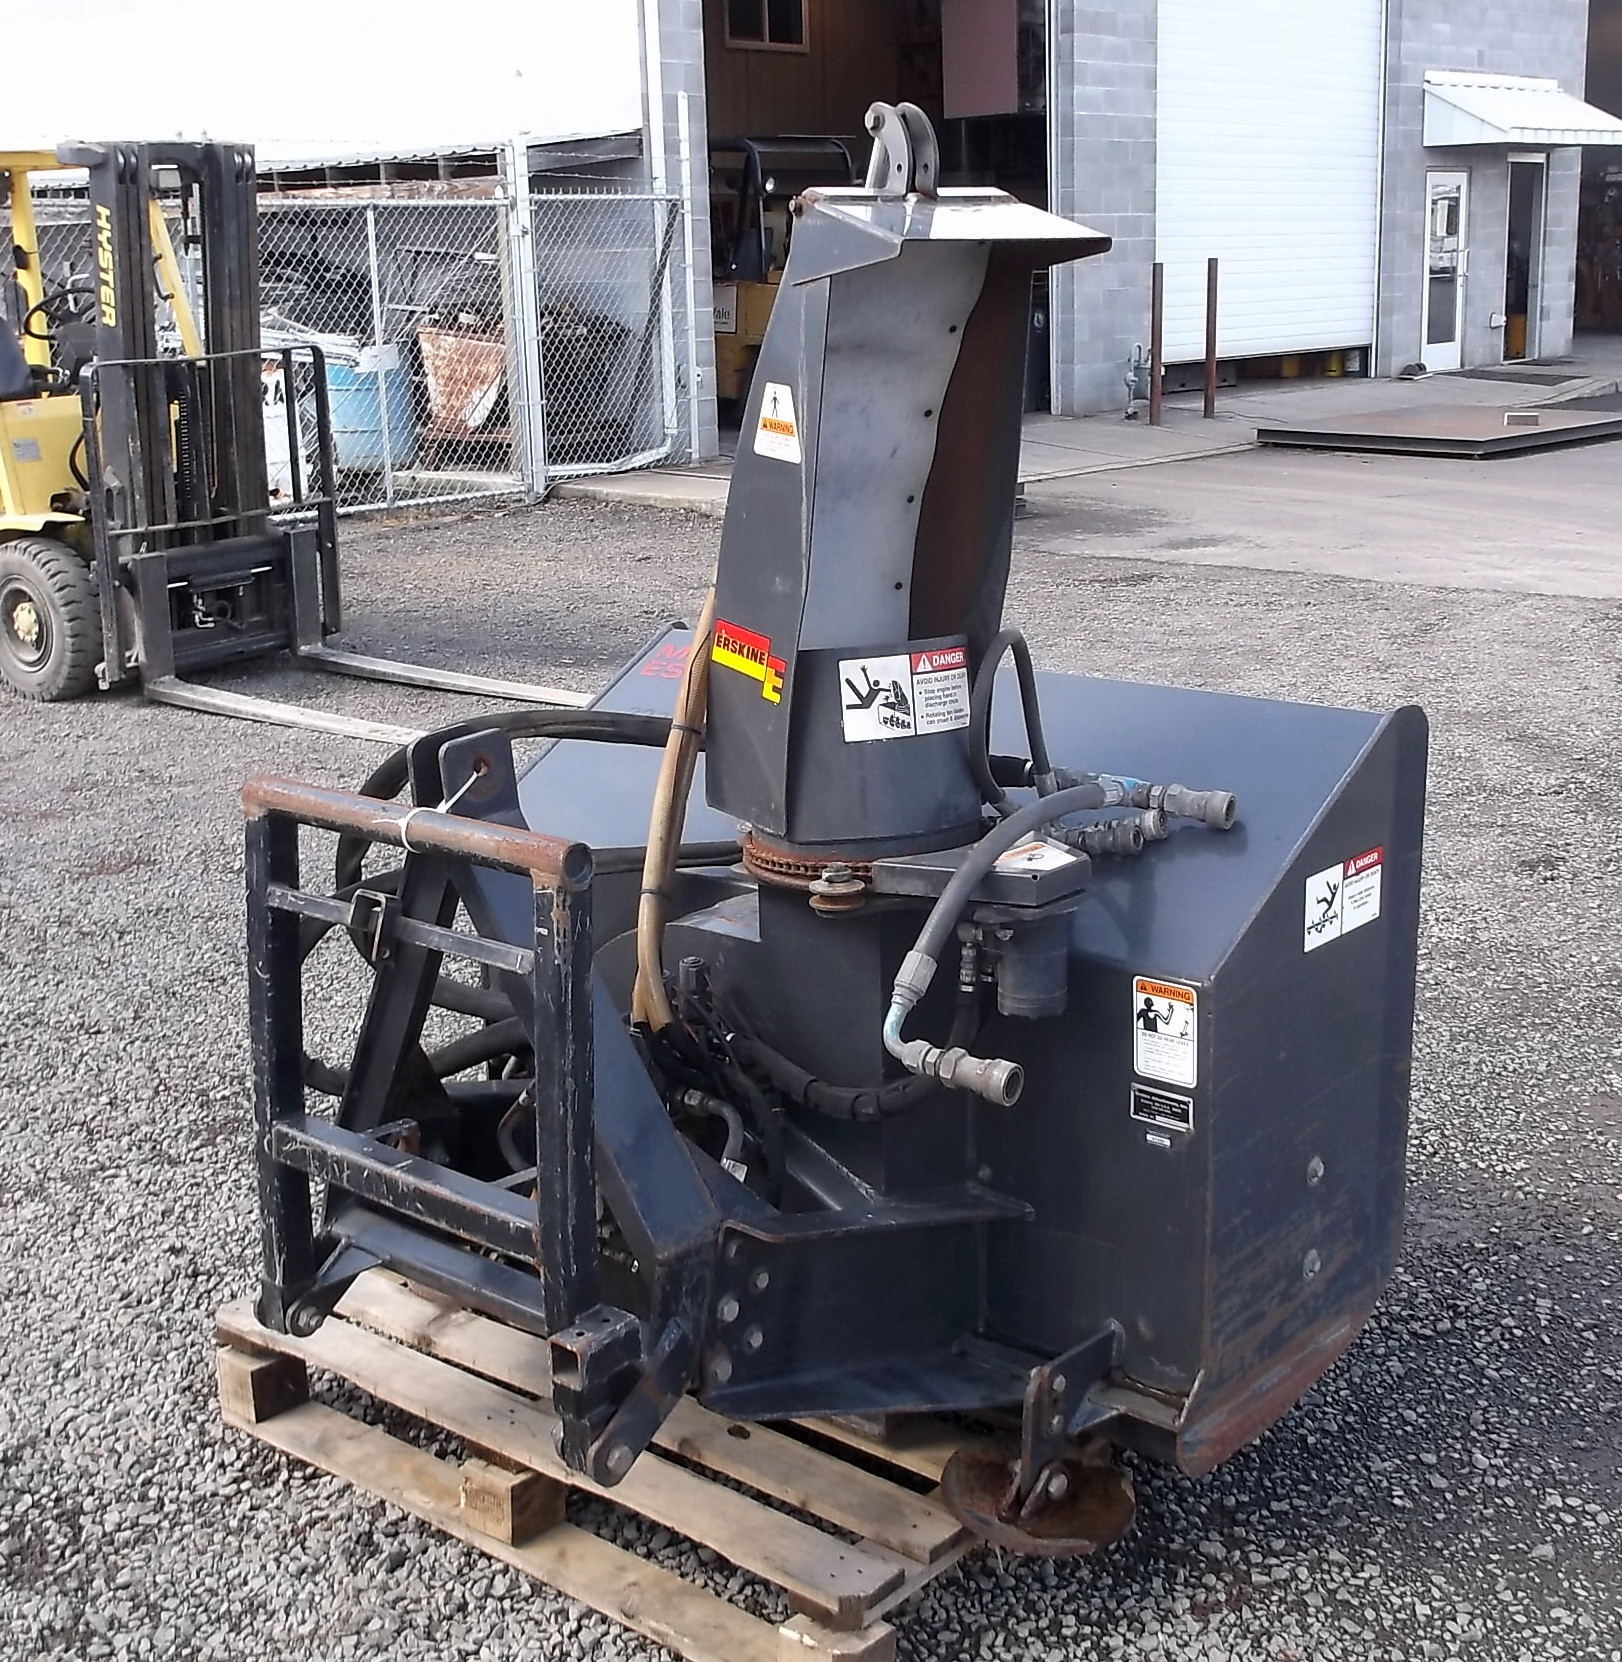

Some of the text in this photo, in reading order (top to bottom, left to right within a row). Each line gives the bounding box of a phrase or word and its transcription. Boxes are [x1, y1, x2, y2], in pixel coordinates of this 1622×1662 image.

[96, 204, 117, 327] HYSTER
[769, 421, 794, 435] WARNING
[716, 634, 768, 666] ERSKINE
[932, 651, 964, 667] DANGER
[916, 677, 933, 686] AVOID
[1355, 852, 1379, 869] DANGER
[1150, 984, 1191, 1001] WARNING
